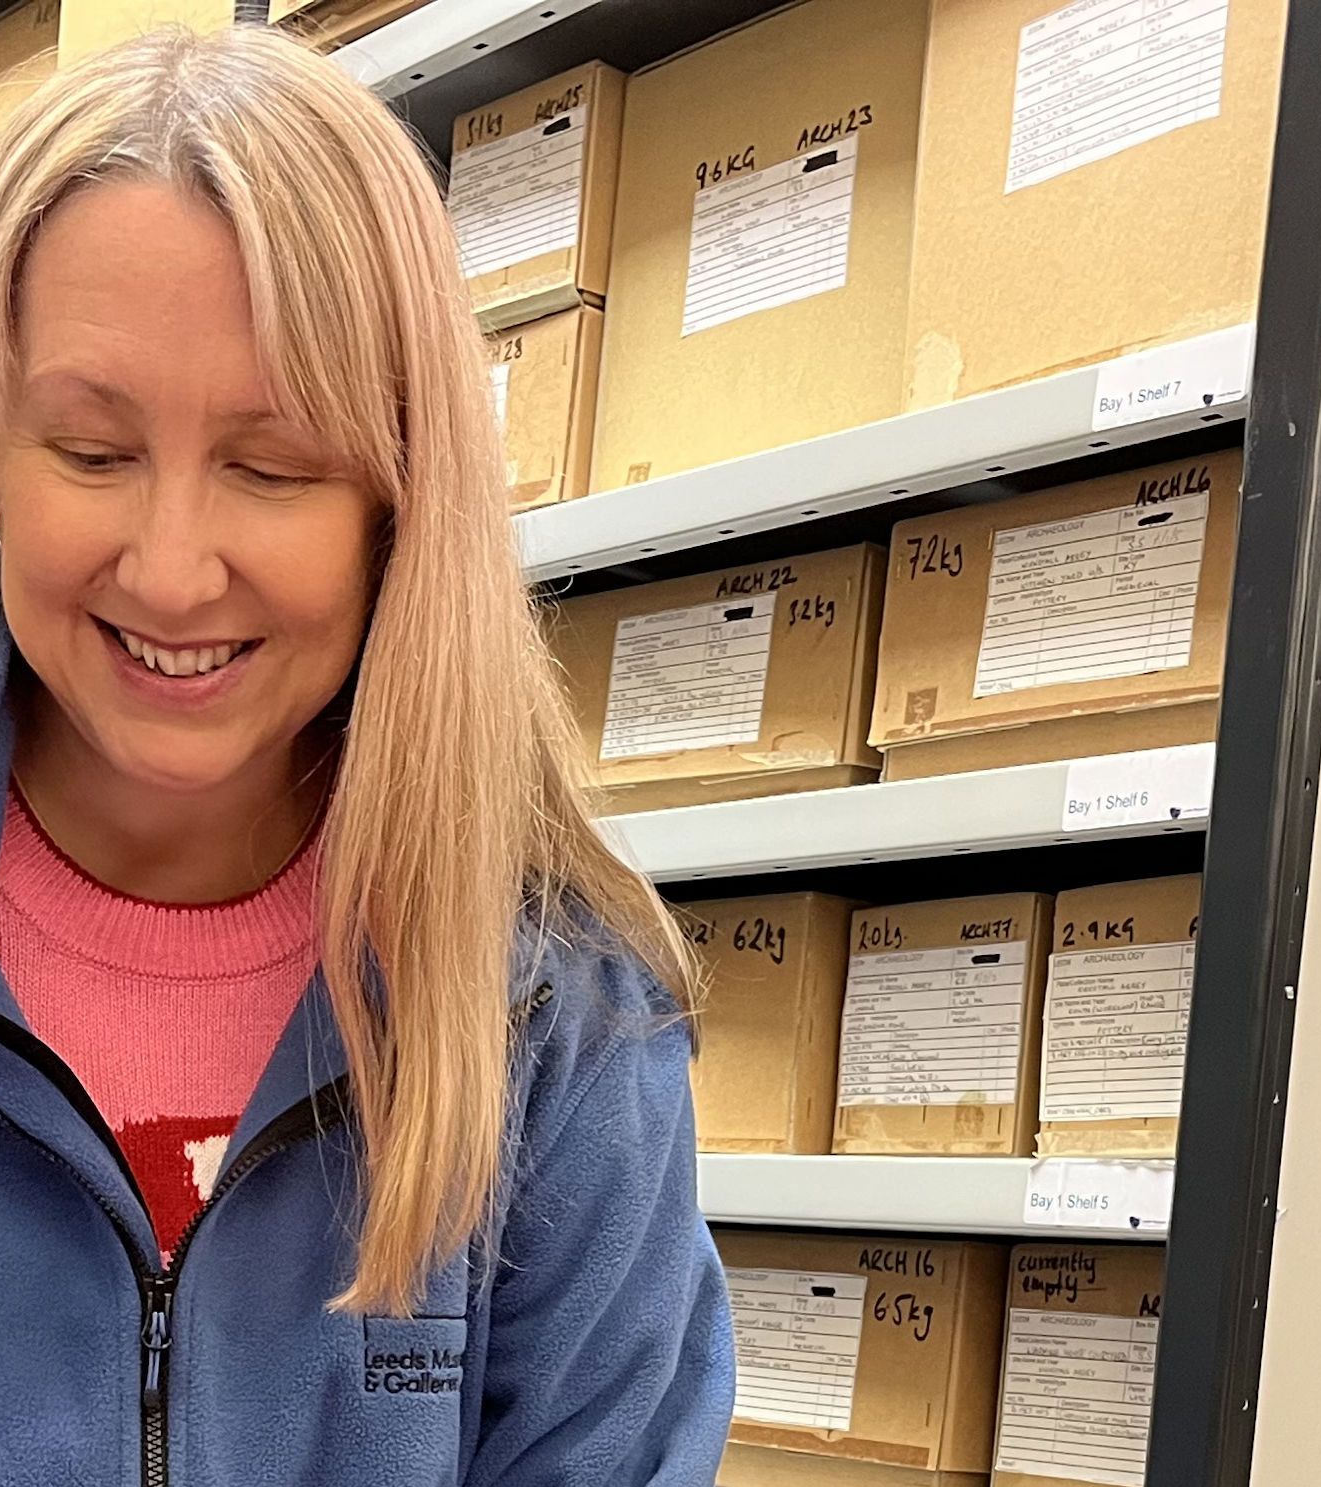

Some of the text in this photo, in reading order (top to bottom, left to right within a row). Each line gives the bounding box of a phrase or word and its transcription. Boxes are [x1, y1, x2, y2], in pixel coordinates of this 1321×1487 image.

[1099, 380, 1182, 413] Bay 1 Shelf 7
[1068, 791, 1149, 815] Bay 1 Shelf 6
[1083, 951, 1145, 965] ARCHAEOLOGY
[1030, 1193, 1109, 1210] Bay 1 Shelf 5
[1018, 1252, 1096, 1284] currently
[1022, 1270, 1079, 1303] empty
[1040, 1316, 1098, 1328] ARCHAEOLOGY
[365, 1347, 426, 1370] Leeds
[365, 1371, 378, 1393] &
